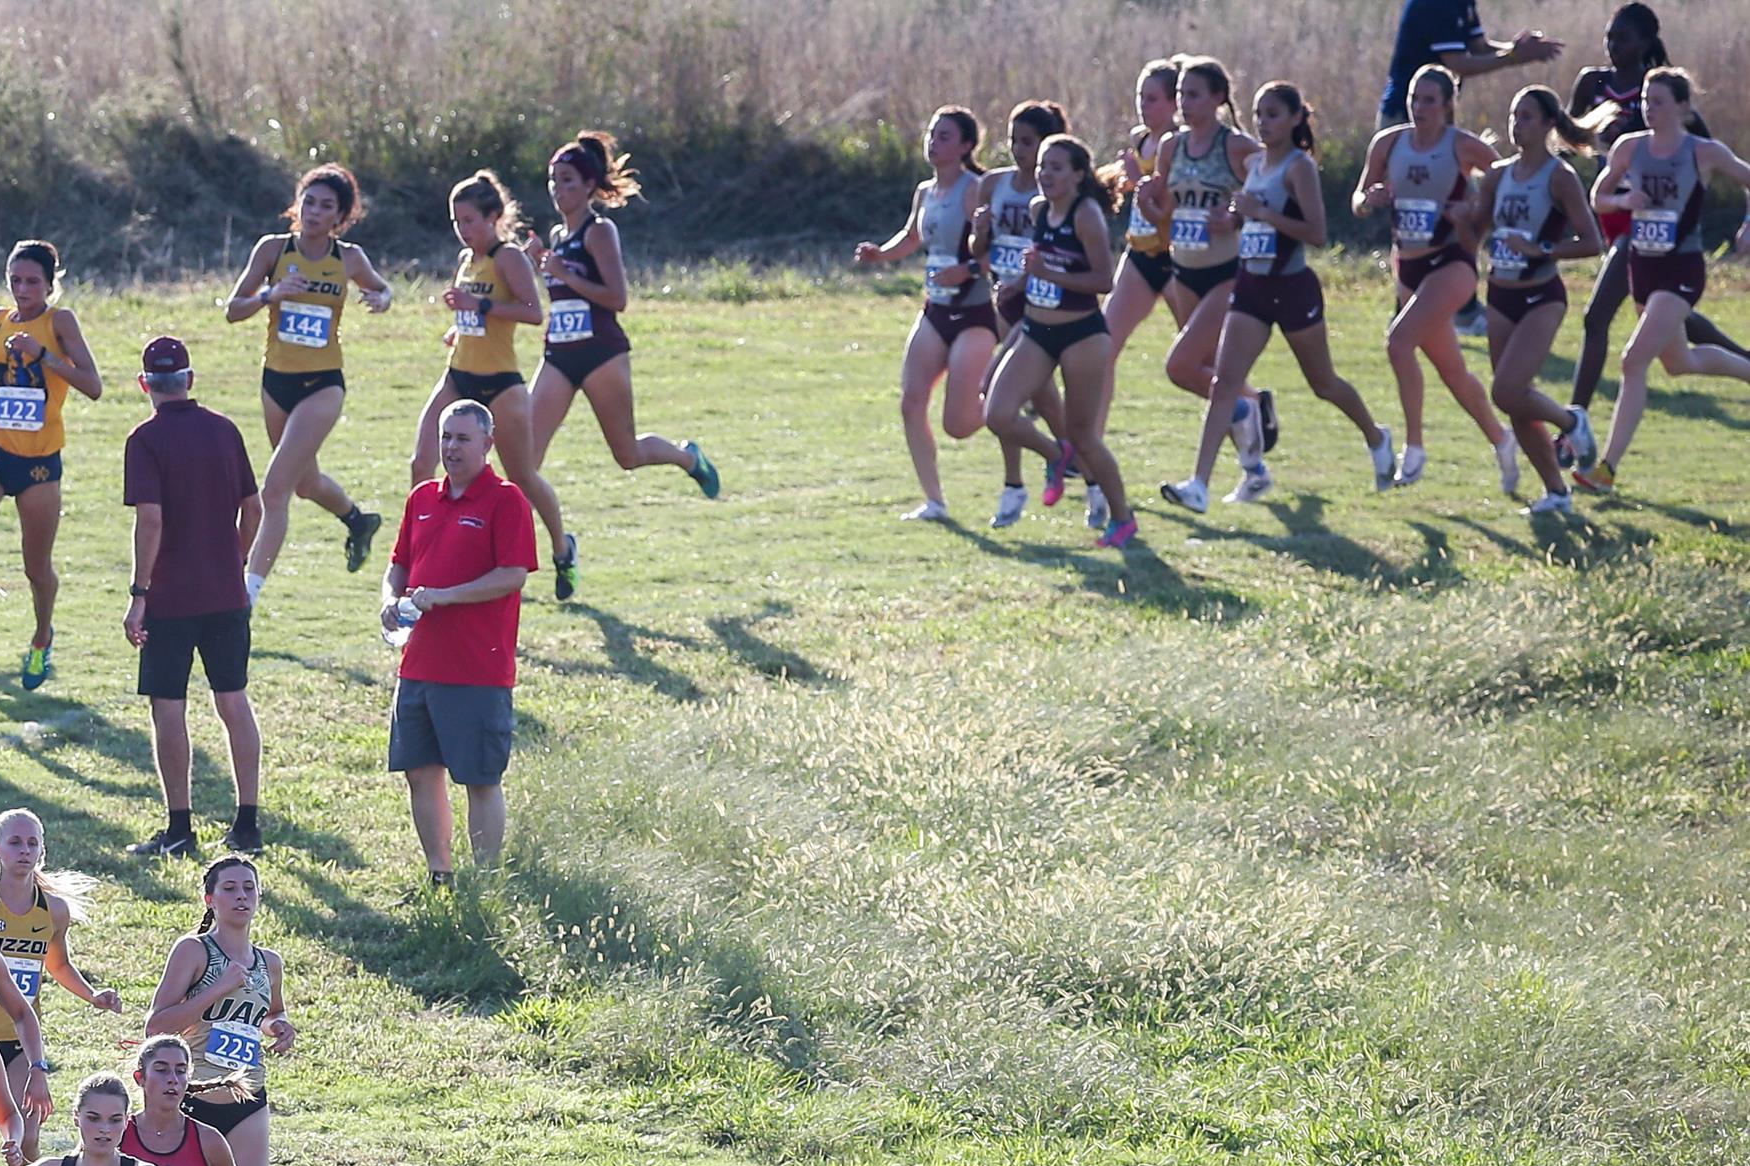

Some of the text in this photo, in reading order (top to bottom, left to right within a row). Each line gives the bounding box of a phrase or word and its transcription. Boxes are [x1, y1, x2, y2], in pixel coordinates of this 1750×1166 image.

[286, 315, 323, 337] 144
[554, 312, 585, 333] 197
[0, 400, 37, 420] 122
[215, 1034, 256, 1063] 225
